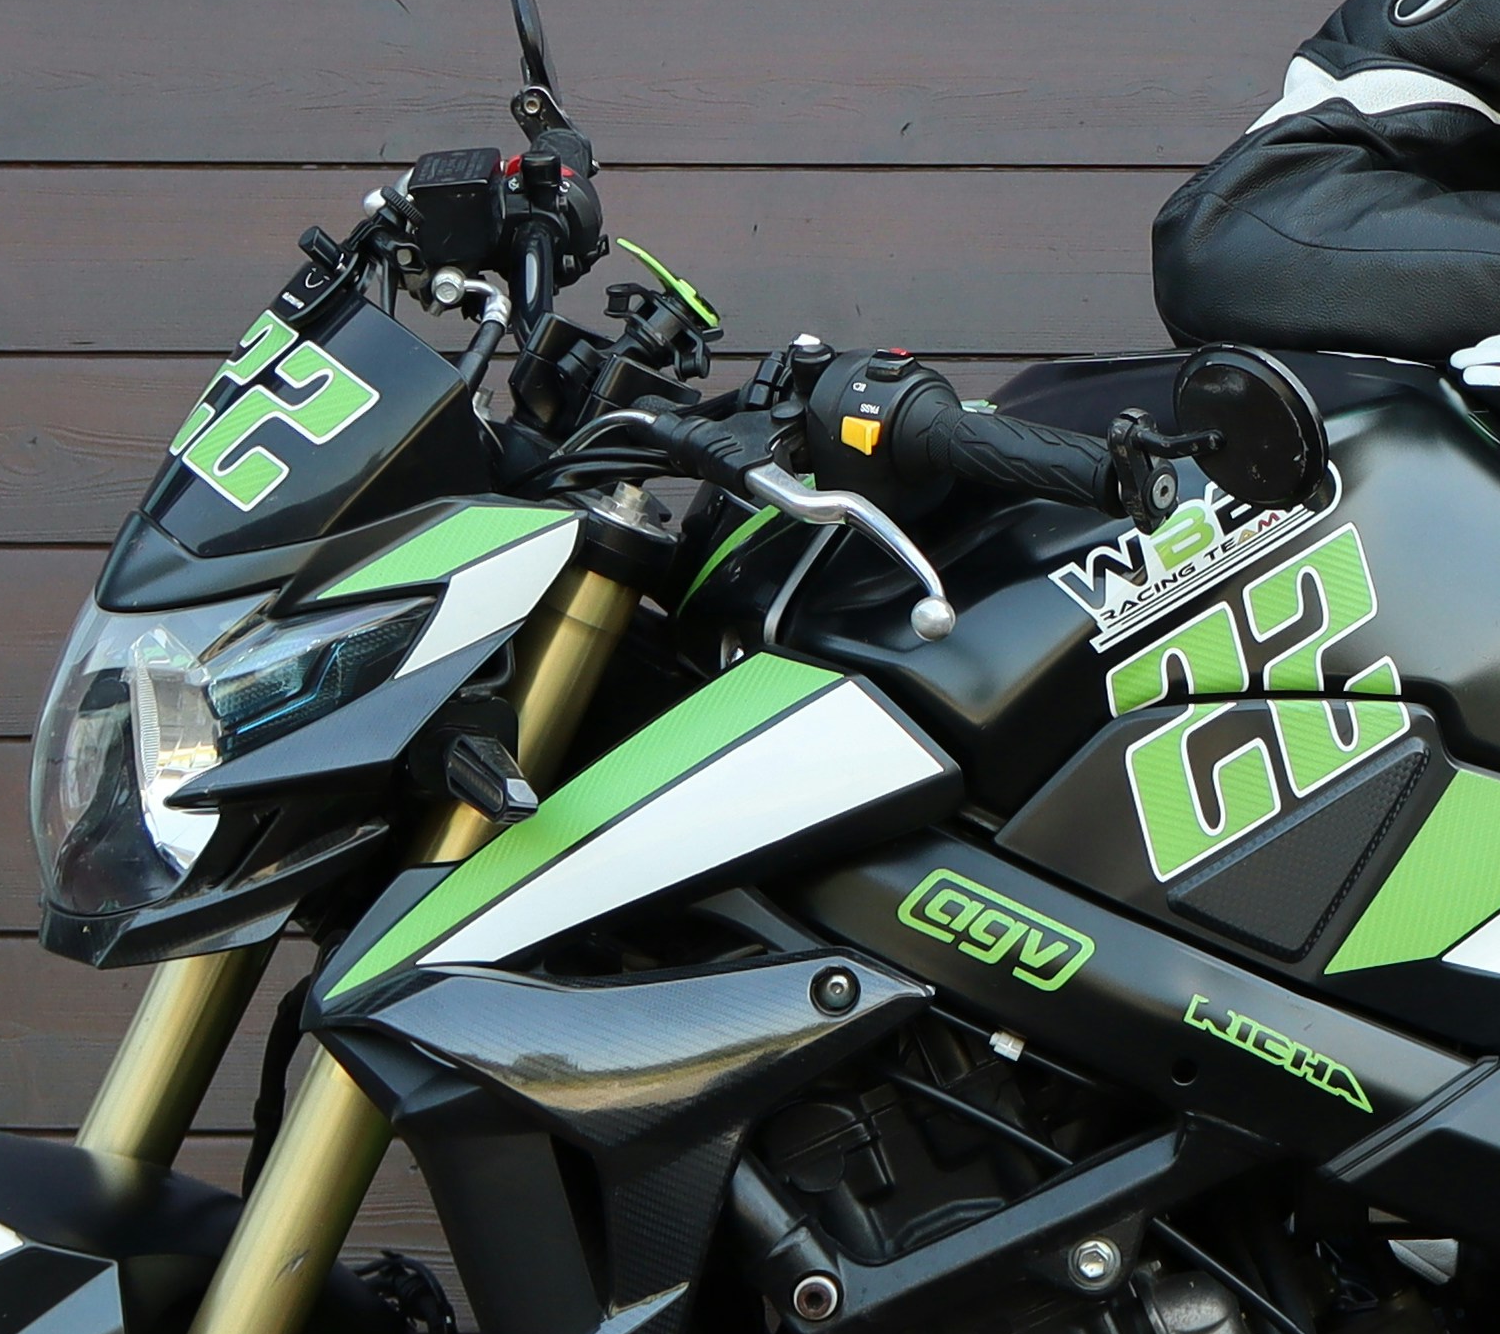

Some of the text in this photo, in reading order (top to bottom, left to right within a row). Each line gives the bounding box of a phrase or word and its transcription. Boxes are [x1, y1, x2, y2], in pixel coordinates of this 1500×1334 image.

[169, 308, 380, 513] 22
[1100, 512, 1282, 622] RACING TEAM
[1107, 522, 1411, 883] 22
[922, 886, 1069, 970] agv
[1182, 993, 1374, 1113] RICHA
